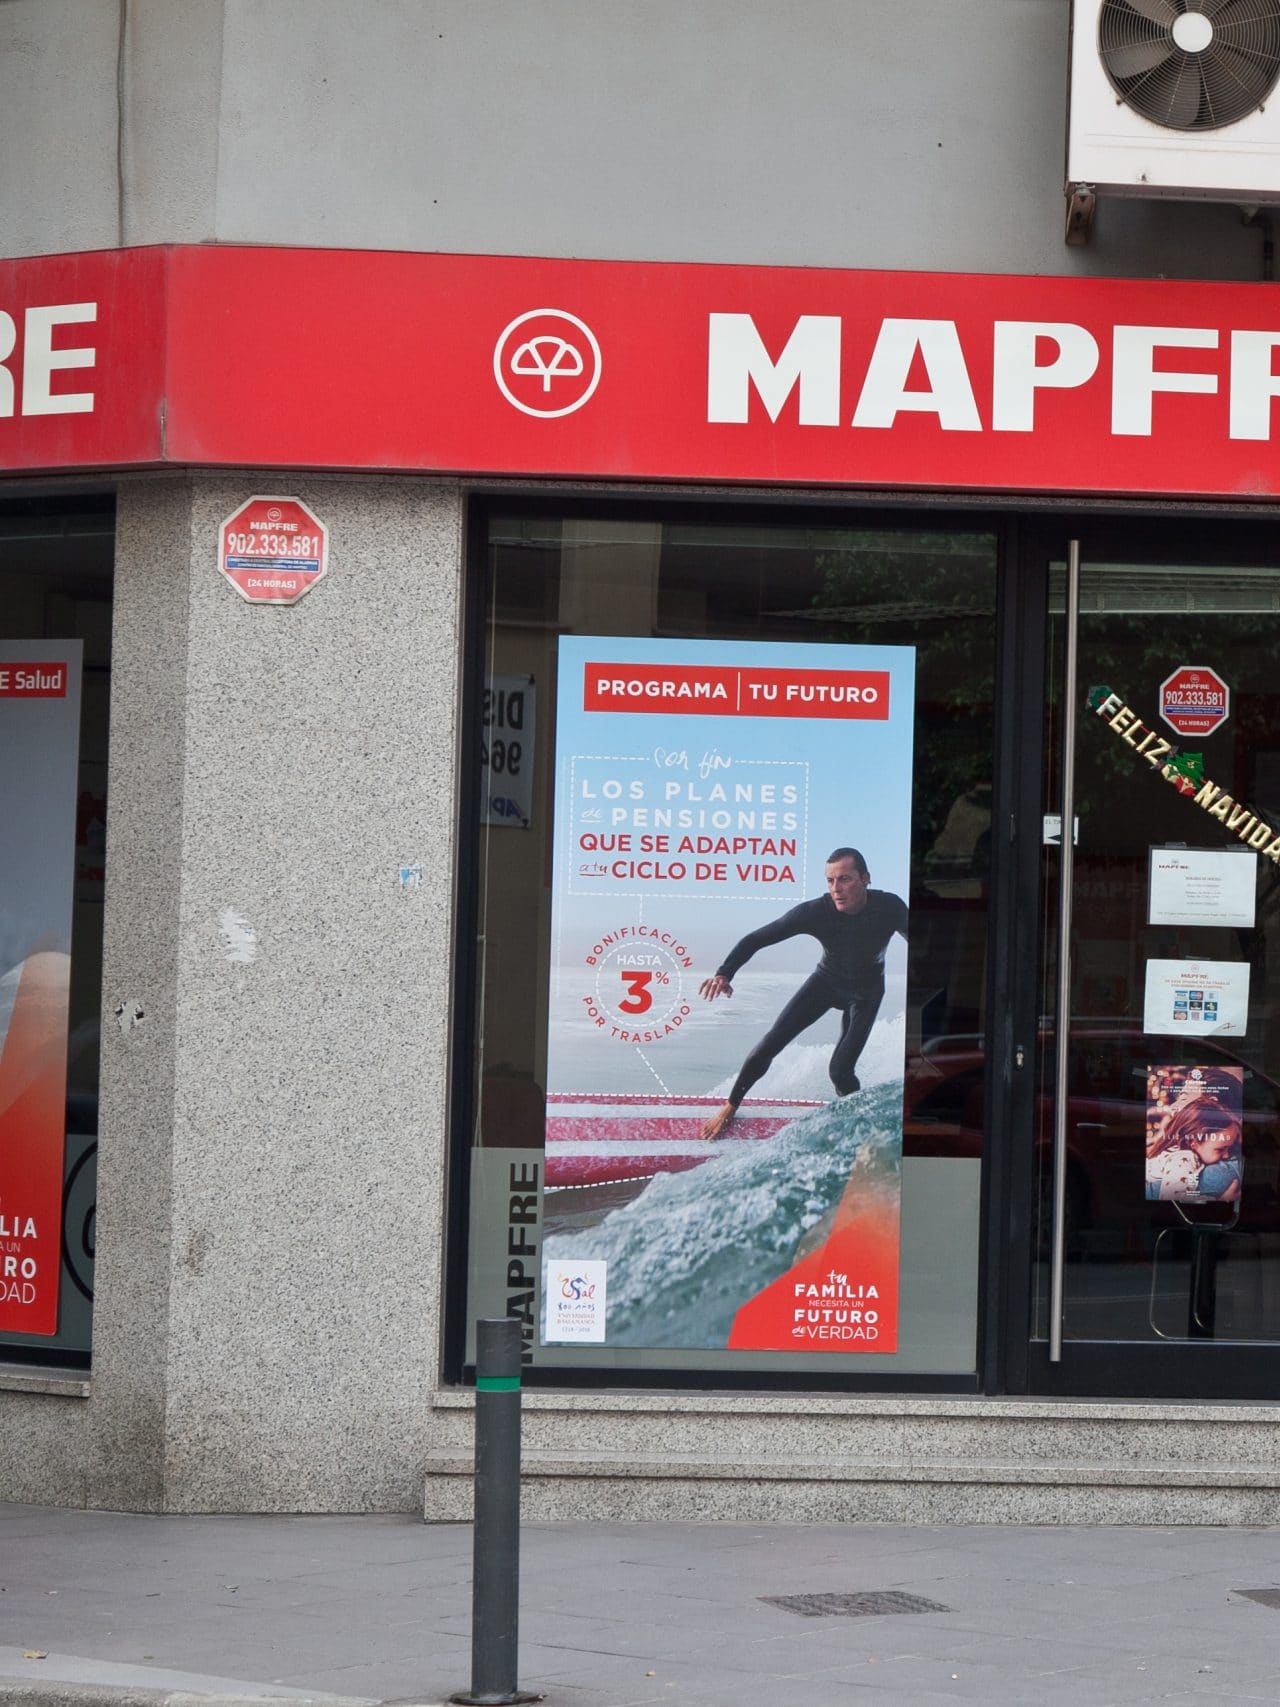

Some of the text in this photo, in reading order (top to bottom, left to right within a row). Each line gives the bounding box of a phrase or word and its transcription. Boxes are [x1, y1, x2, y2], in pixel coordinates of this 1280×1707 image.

[0, 302, 97, 417] E
[249, 521, 299, 532] MAPFRE
[227, 532, 320, 557] 902.333.581
[15, 669, 61, 690] Salud
[597, 679, 878, 704] PROGRAMA TU FUTURO
[1165, 690, 1224, 706] 902.333.581
[1096, 693, 1172, 766] FELIZ
[582, 779, 798, 805] LOS PLANES
[612, 807, 798, 831] PENSIONES
[579, 833, 796, 856] QUE SE ADAPTAN
[612, 861, 687, 880] CICLO
[695, 863, 728, 881] DE
[736, 864, 796, 883] VIDA
[586, 925, 693, 968] BONIFICACIÓN
[617, 954, 662, 966] HASTA
[582, 996, 606, 1028] POR
[6, 1242, 21, 1253] UN
[827, 1269, 848, 1286] tu
[794, 1283, 879, 1299] FAMILIA
[808, 1299, 850, 1308] NECESITA
[794, 1308, 879, 1324] FUTURO
[806, 1326, 879, 1340] VERDAD
